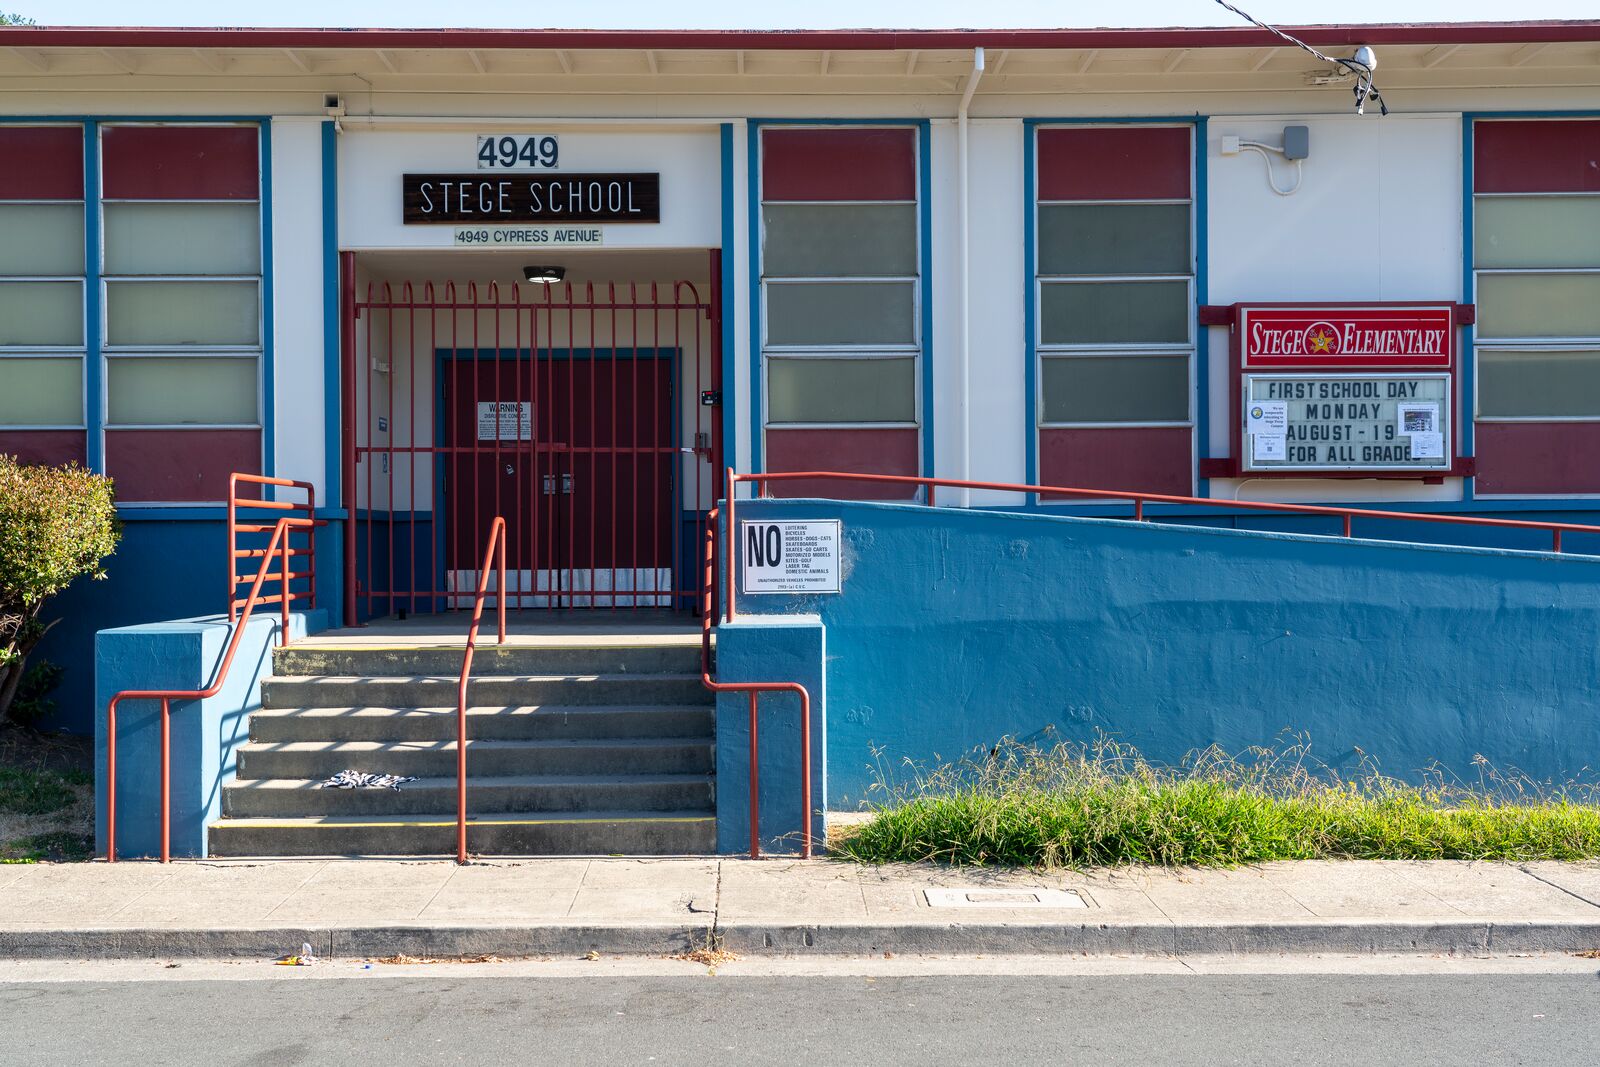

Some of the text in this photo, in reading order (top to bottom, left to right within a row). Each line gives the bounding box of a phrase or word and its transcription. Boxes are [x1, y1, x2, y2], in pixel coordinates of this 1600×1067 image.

[478, 136, 559, 168] 4949
[420, 181, 641, 213] STEGE SCHOOL
[458, 229, 599, 242] 4949 CYPRESS AVENUE
[1341, 322, 1446, 355] ELEMENTARY
[1269, 382, 1418, 399] FIRST SCHOOL DAY
[489, 404, 523, 412] WRNING
[1306, 404, 1381, 420] MONDAY
[1286, 424, 1352, 440] AUGUST
[1374, 424, 1394, 440] 19
[1289, 446, 1317, 462] FOR
[1328, 446, 1355, 462] ALL
[1362, 445, 1421, 462] GRADE
[748, 525, 782, 567] NO
